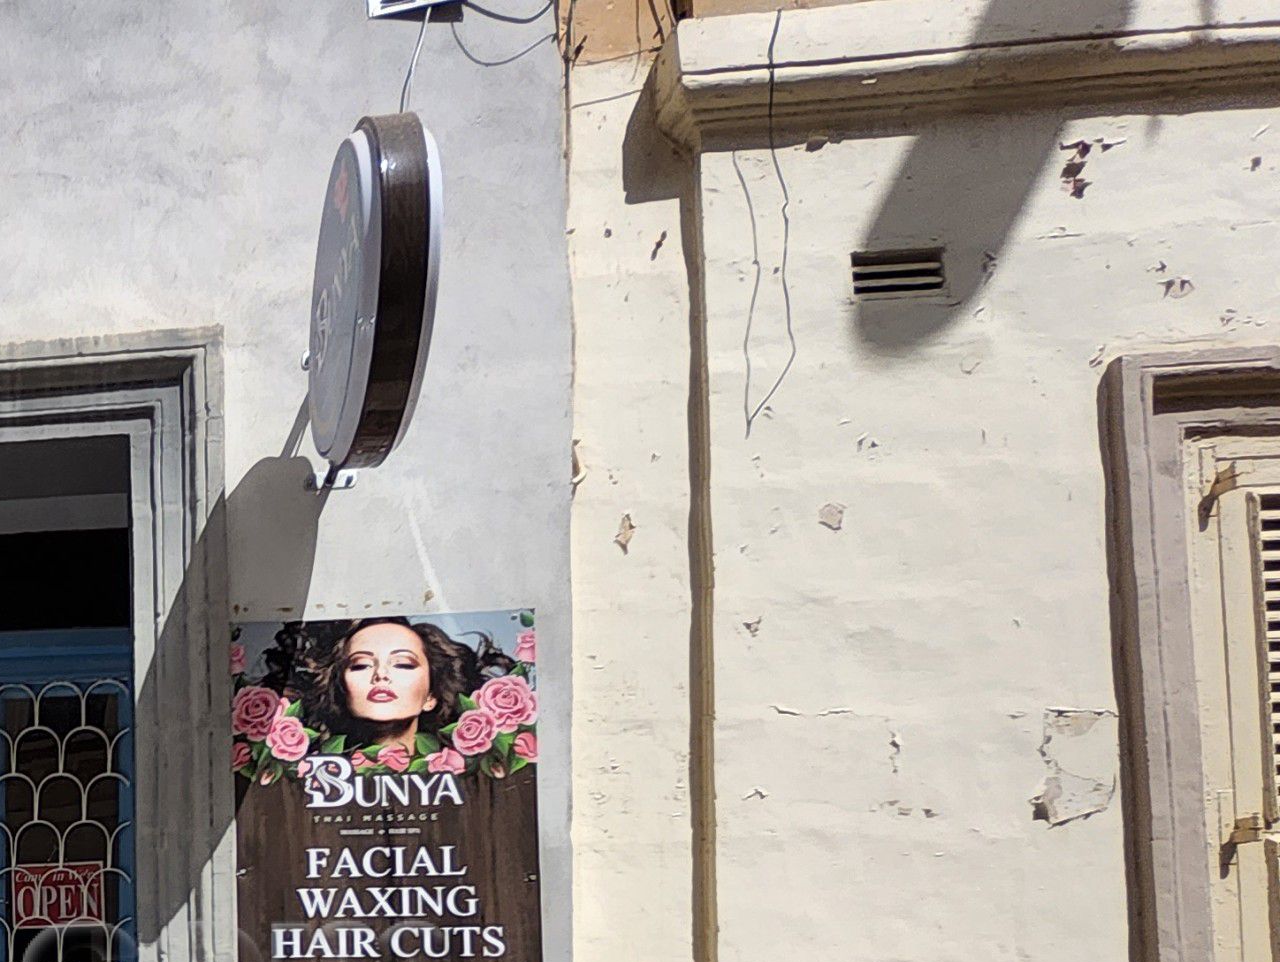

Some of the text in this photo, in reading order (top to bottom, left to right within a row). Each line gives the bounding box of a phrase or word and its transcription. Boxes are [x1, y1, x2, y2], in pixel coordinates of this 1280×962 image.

[304, 755, 464, 808] BUNYA
[314, 813, 439, 823] THAI MASSAGE
[305, 845, 468, 879] FACIAL
[17, 883, 99, 919] OPEN
[296, 885, 480, 919] WAXING
[272, 926, 506, 959] HAIR CUTS
